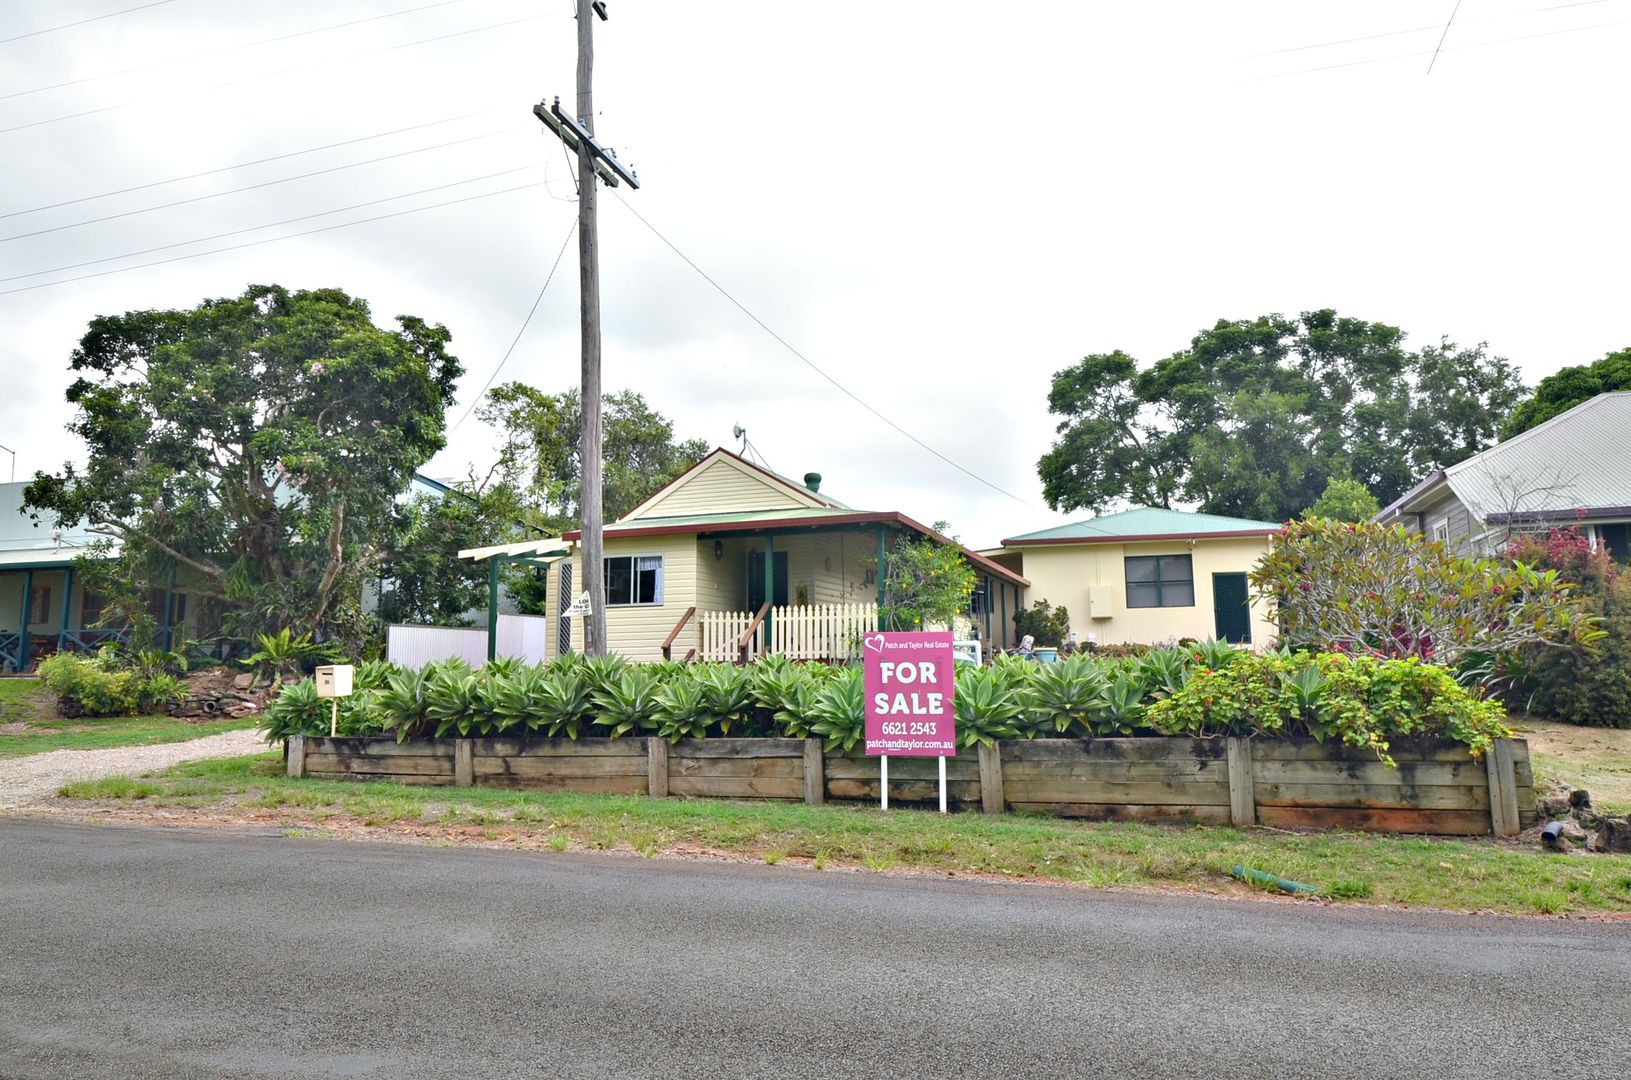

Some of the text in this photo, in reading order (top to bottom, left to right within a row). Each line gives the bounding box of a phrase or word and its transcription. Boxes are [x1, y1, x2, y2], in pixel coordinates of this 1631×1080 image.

[909, 641, 923, 650] Taylor
[924, 641, 934, 649] Real
[880, 662, 937, 684] FOR
[874, 693, 944, 714] SALE
[882, 722, 936, 735] 6621 2543
[866, 739, 953, 750] patchandtaylor.com.au
